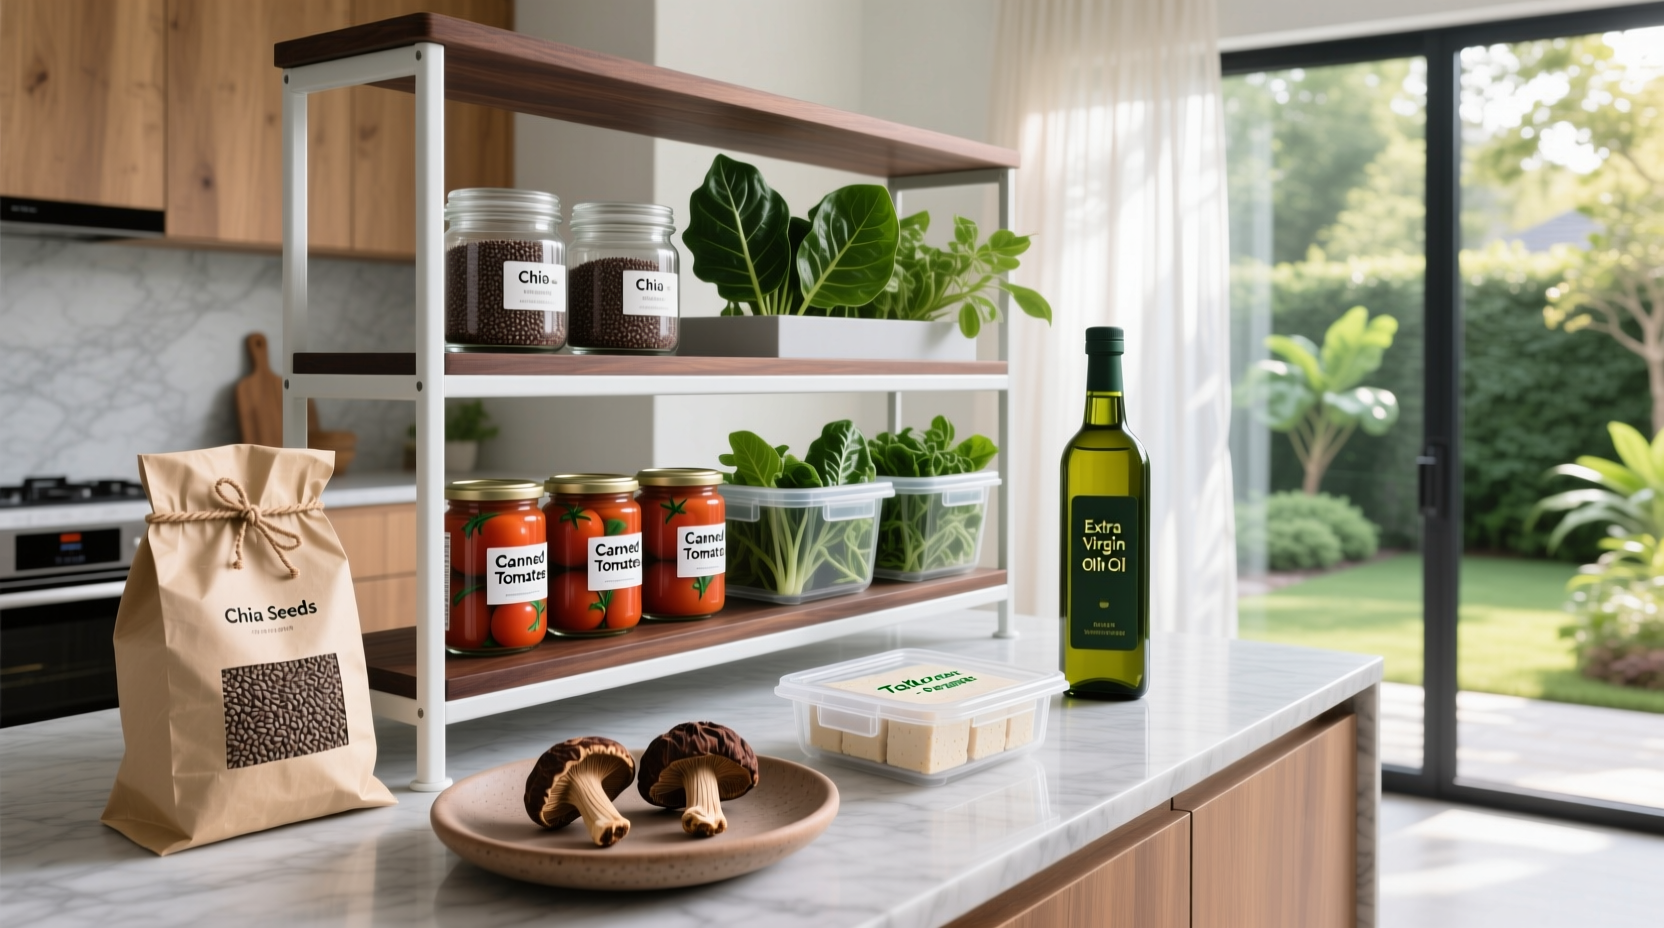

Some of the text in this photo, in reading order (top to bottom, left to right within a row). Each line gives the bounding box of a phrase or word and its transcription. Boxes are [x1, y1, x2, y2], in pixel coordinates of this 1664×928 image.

[1084, 519, 1122, 534] Extra
[1082, 535, 1126, 556] Virgin
[224, 599, 318, 624] Chia Seeds
